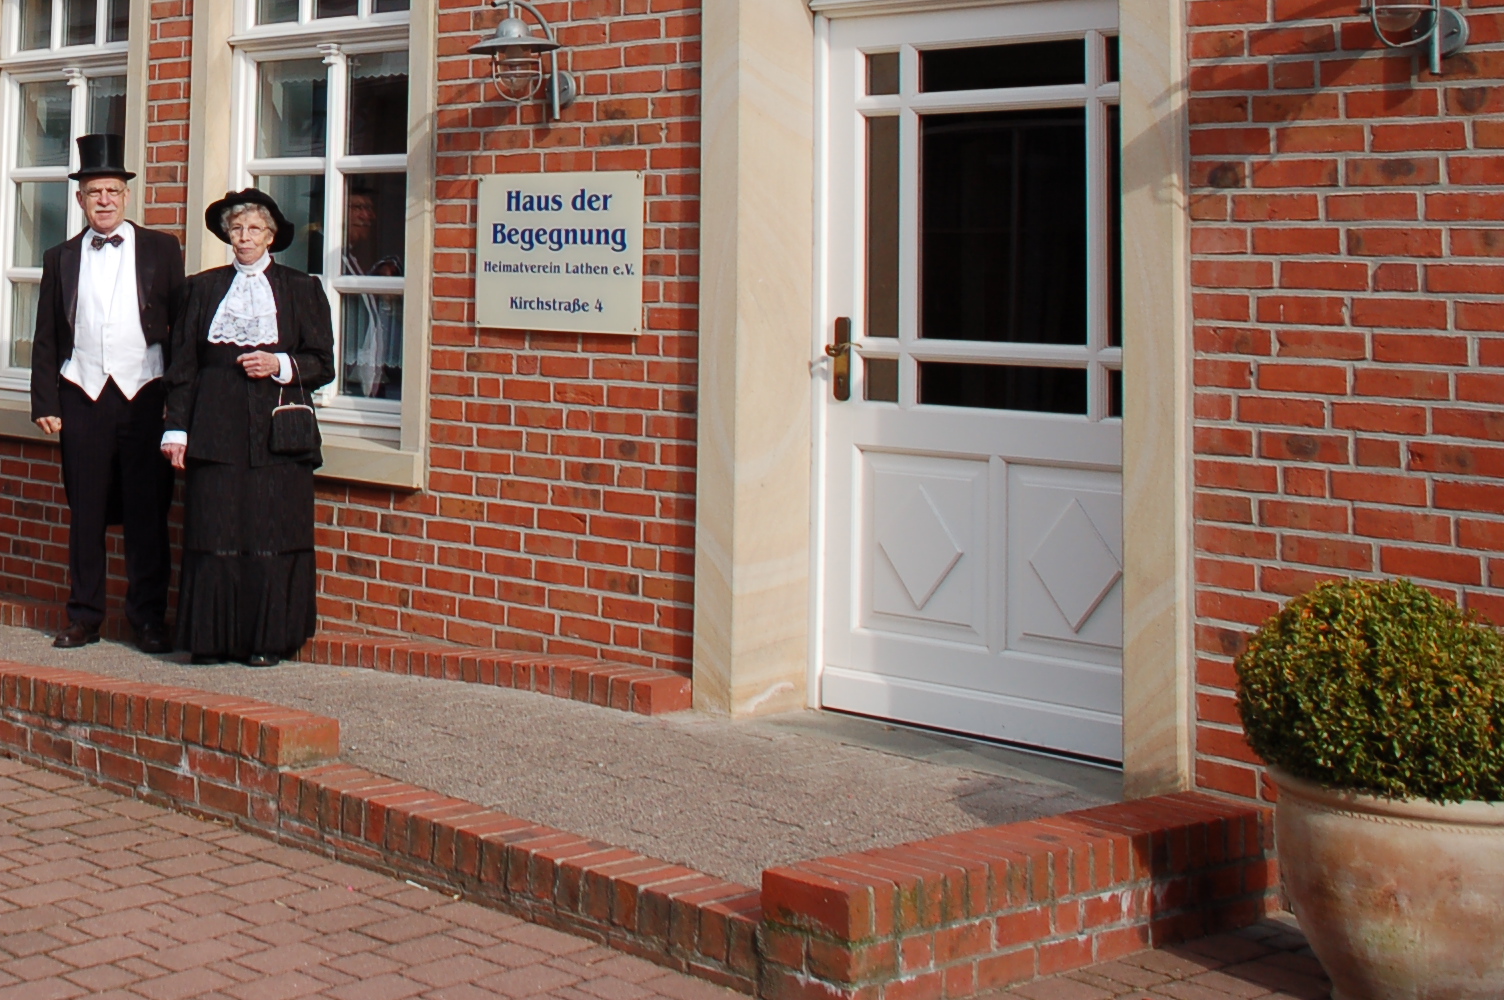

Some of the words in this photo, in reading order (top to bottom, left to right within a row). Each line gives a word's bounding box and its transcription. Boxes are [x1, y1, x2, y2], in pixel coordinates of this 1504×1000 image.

[506, 190, 562, 212] Haus
[571, 188, 613, 211] der
[492, 223, 627, 252] Begegnung
[484, 261, 561, 274] Heimatverein
[565, 262, 609, 275] Lathen
[613, 263, 635, 276] e.V.
[510, 296, 589, 314] Kirchstraße
[594, 298, 603, 313] 4
